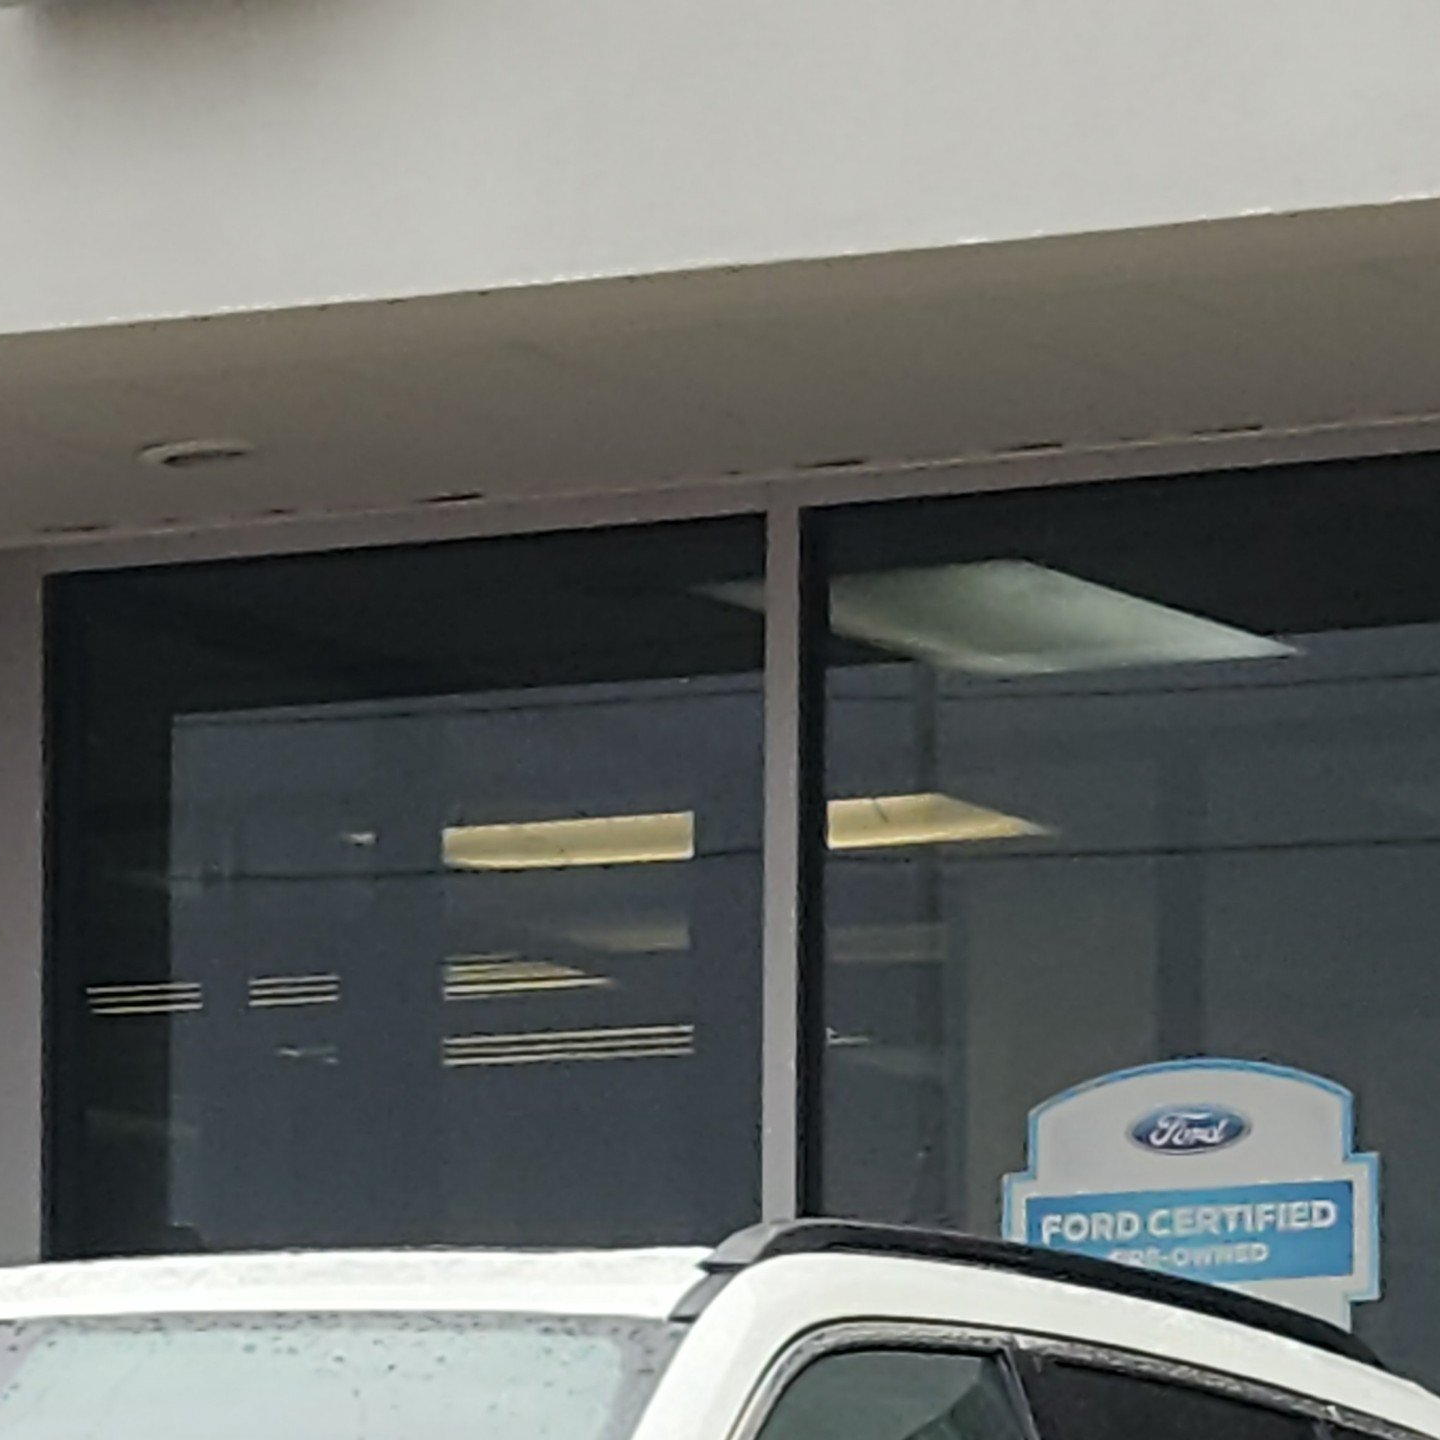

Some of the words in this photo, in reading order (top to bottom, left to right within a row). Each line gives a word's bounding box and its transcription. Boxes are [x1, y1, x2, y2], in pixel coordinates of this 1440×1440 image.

[1149, 1113, 1224, 1147] Ford
[1041, 1212, 1140, 1245] FORD
[1147, 1200, 1338, 1237] CERTIFIED
